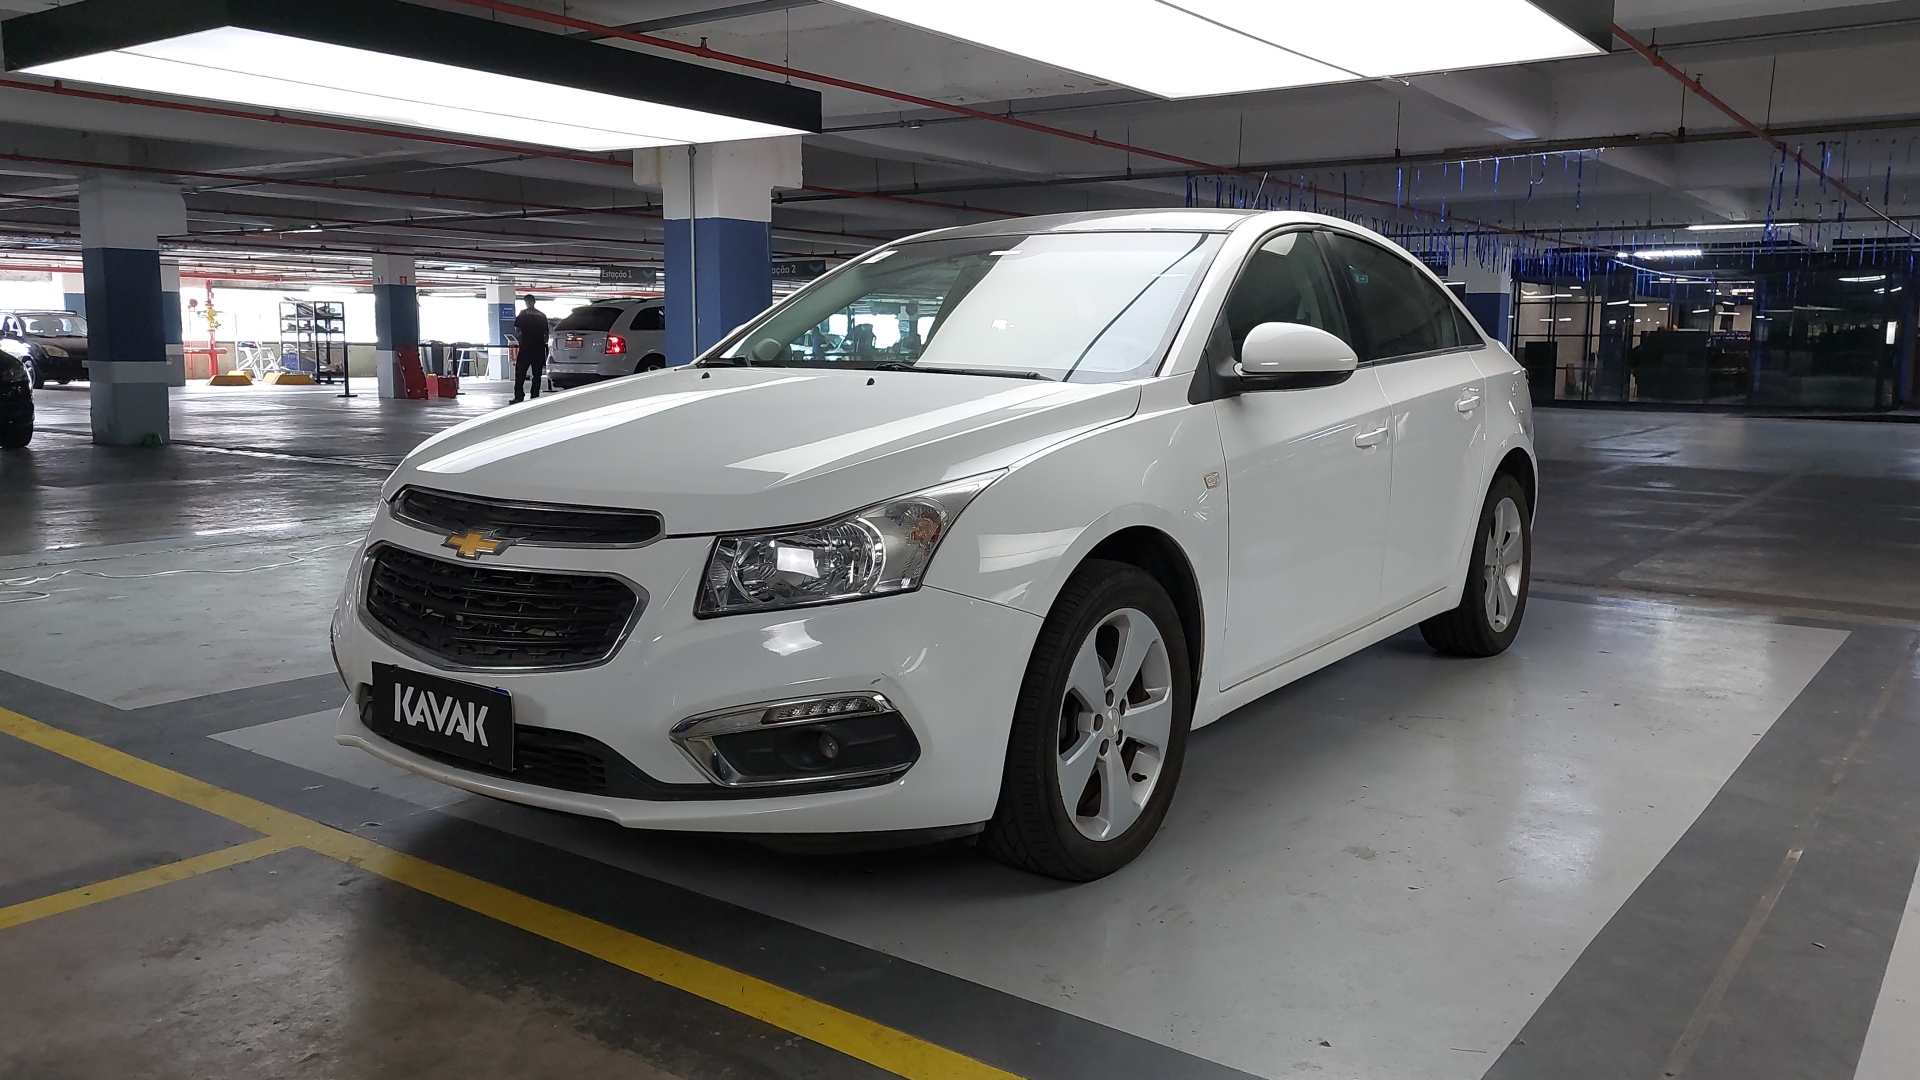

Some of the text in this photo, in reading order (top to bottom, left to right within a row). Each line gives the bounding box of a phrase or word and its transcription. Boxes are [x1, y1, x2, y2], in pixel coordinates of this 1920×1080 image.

[601, 270, 627, 279] Estação
[772, 264, 796, 275] ação 2
[394, 682, 489, 747] KAVAK
